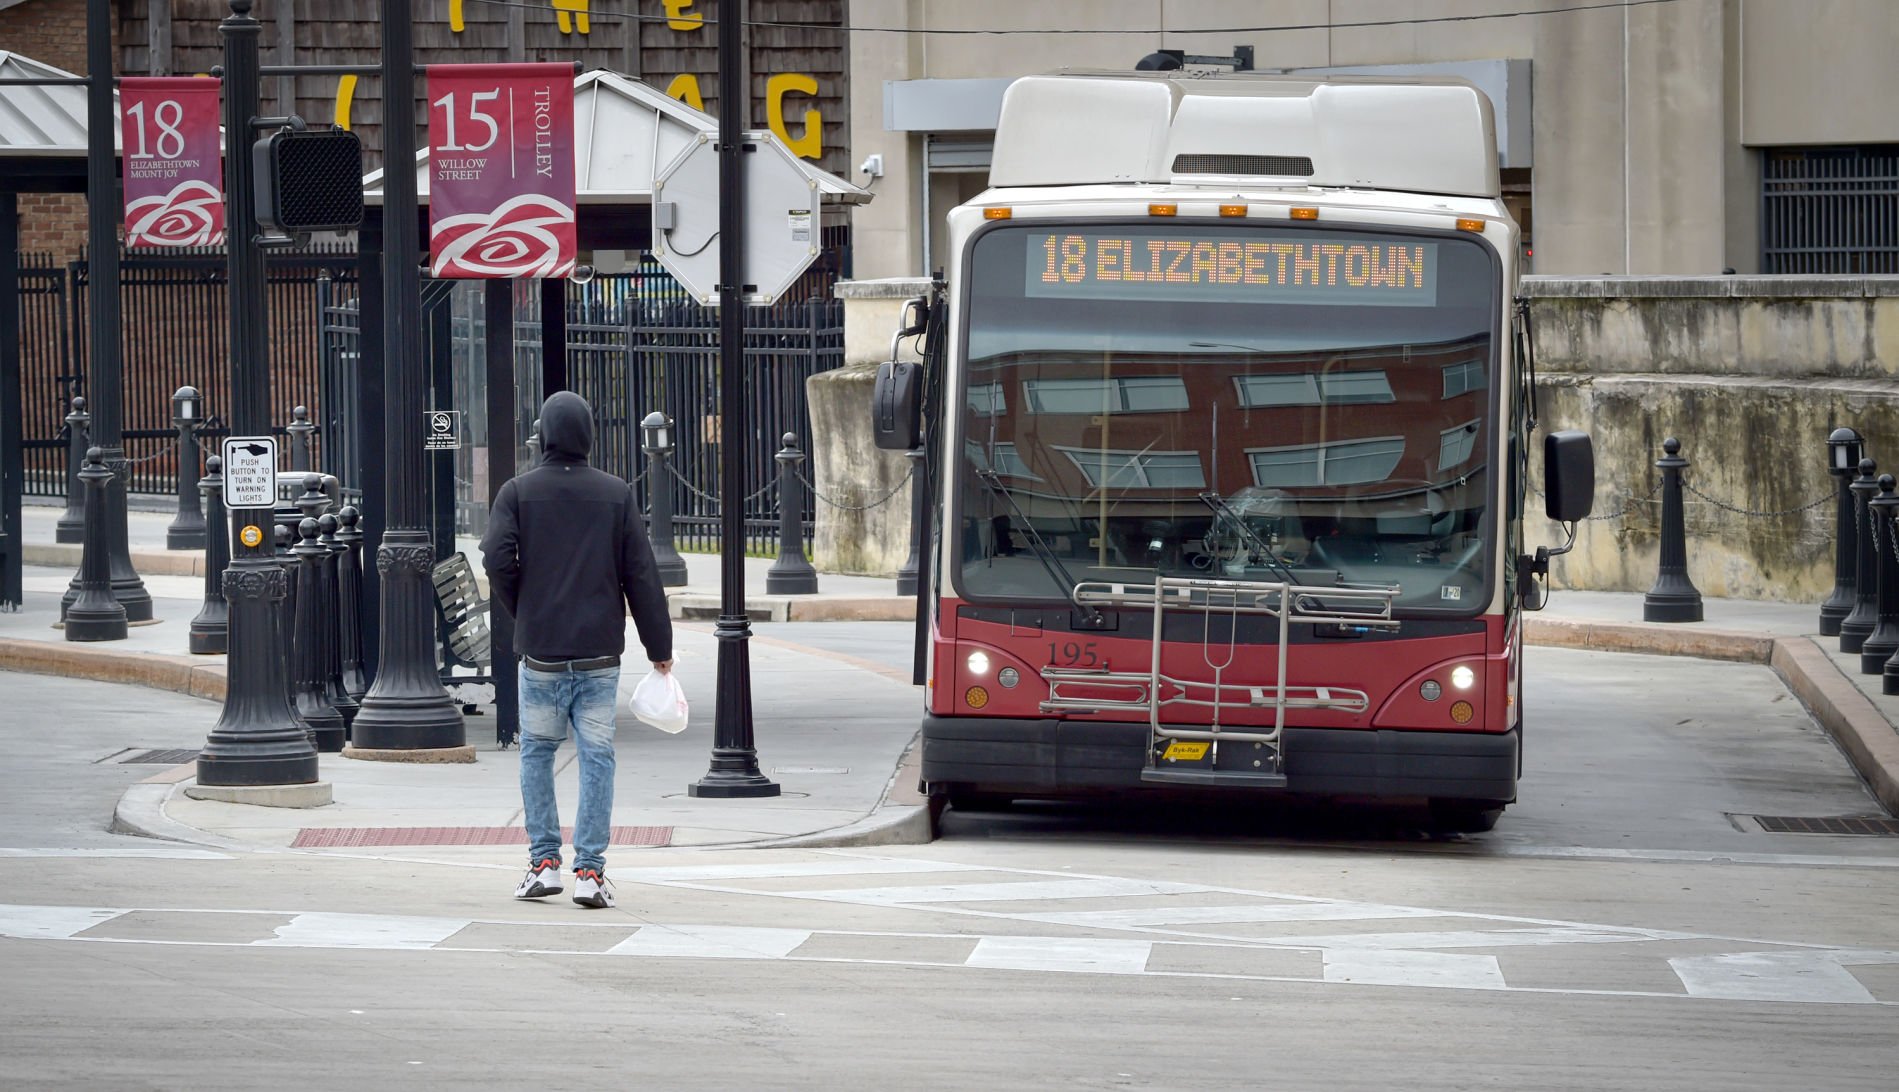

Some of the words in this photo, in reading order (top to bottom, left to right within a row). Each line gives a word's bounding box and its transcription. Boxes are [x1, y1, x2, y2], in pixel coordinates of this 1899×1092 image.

[433, 87, 499, 152] 15
[126, 100, 185, 159] 18
[534, 86, 552, 179] TROLLEY
[130, 160, 200, 170] ELIZABETHTOWN
[438, 159, 488, 169] WILLOW
[130, 170, 163, 179] MOUNT
[164, 170, 178, 180] JOY
[438, 170, 482, 180] STREET
[1042, 235, 1087, 283] 18
[1096, 239, 1424, 288] ELIZABETHTOWN
[240, 458, 260, 467] PUSH
[230, 467, 257, 476] BUTTON
[261, 467, 271, 476] TO
[235, 476, 252, 485] TURN
[256, 476, 267, 485] ON
[235, 485, 266, 494] WARNING
[239, 494, 263, 503] LIGHTS
[1047, 641, 1097, 667] 195
